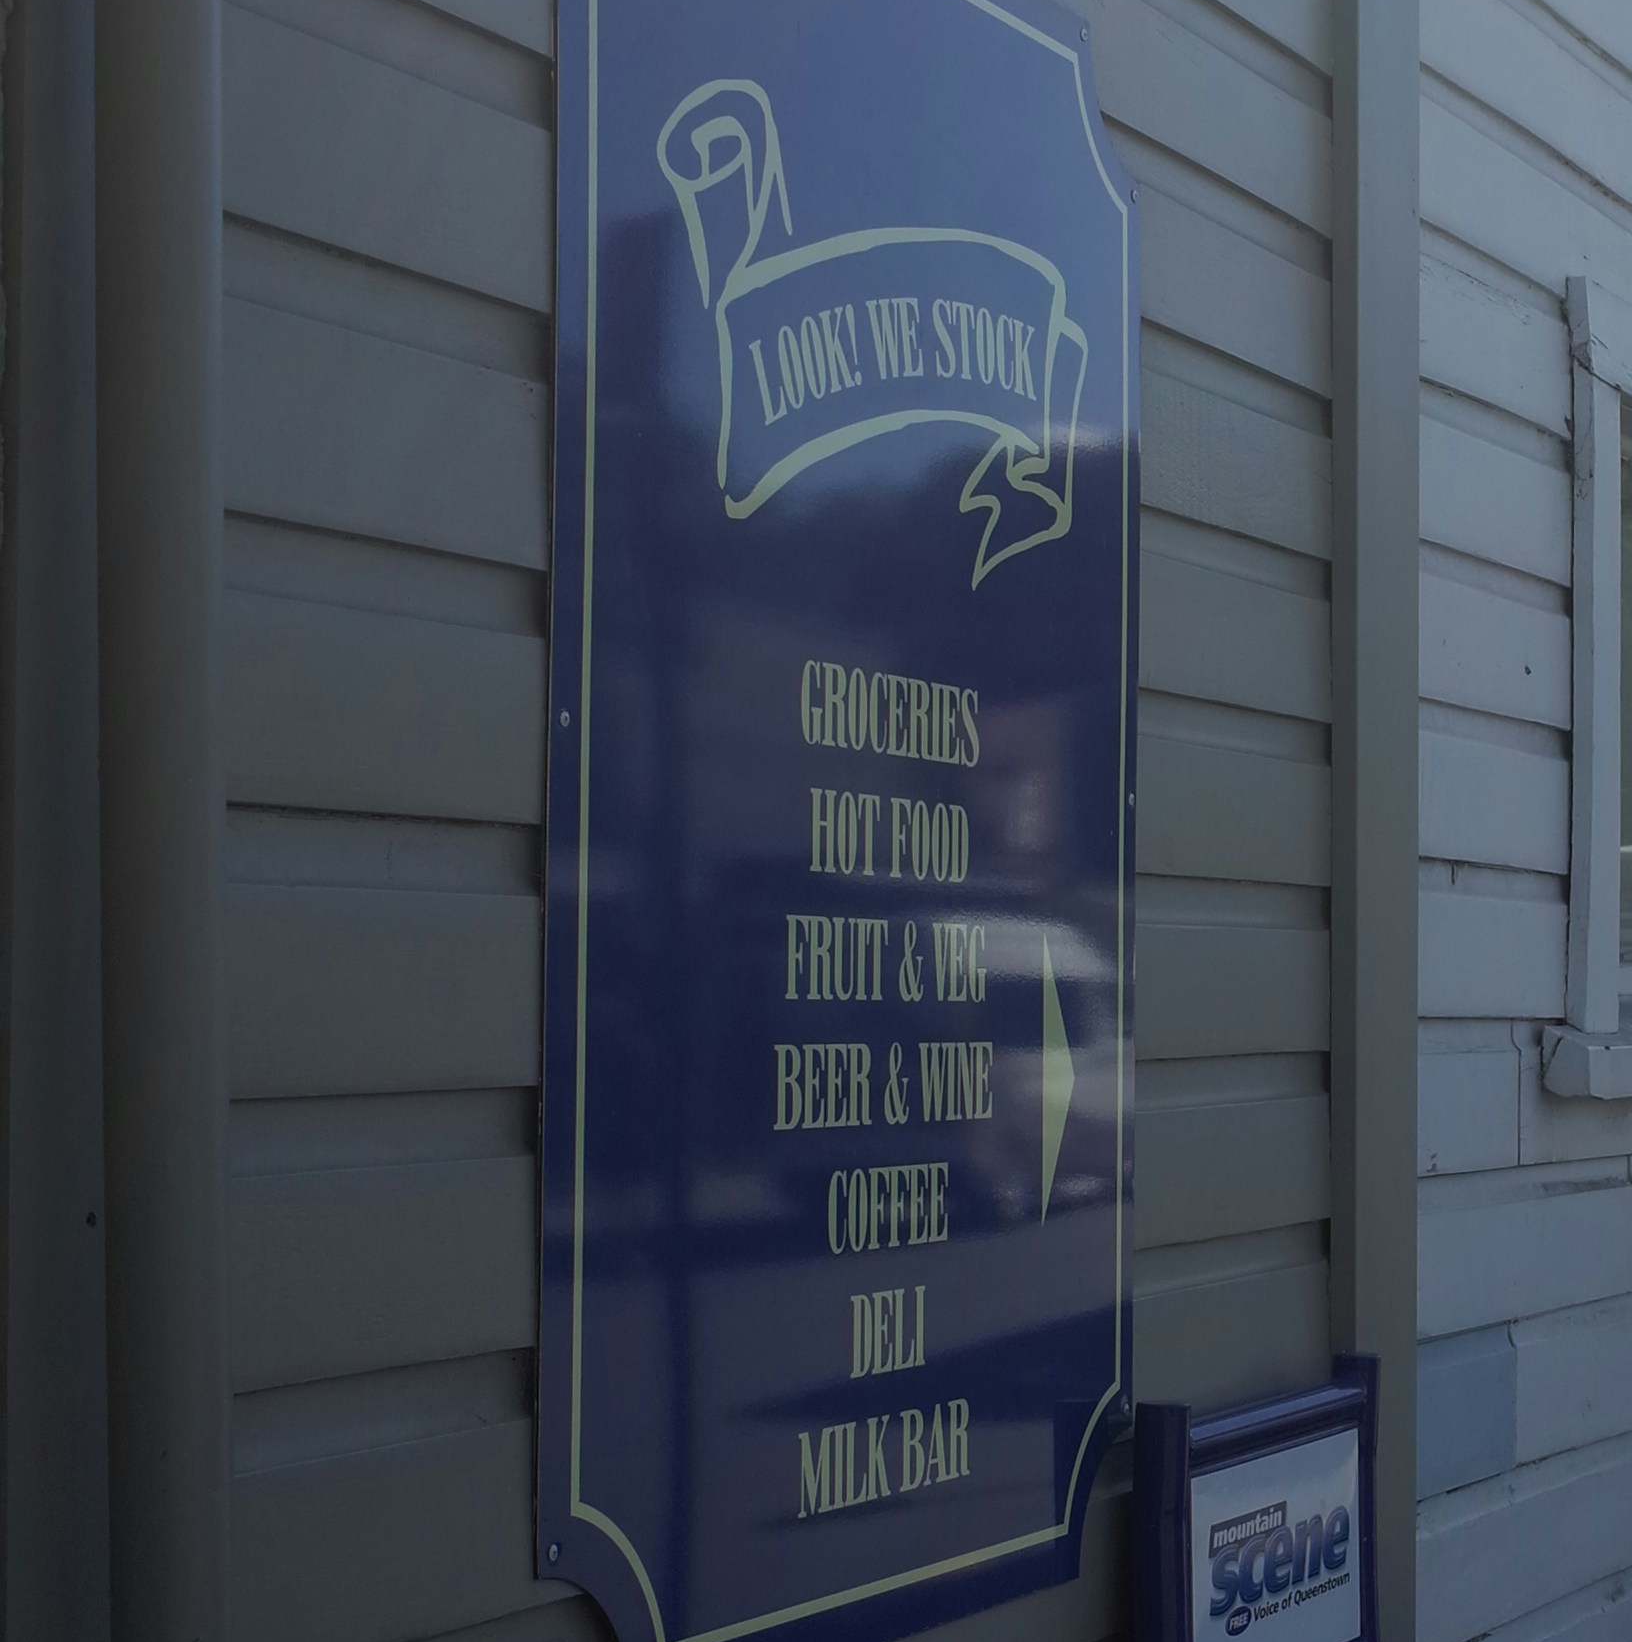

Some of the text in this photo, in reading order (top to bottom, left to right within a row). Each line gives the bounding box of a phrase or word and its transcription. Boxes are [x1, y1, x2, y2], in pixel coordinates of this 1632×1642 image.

[750, 297, 1038, 426] LOOK! WE STOCK
[801, 658, 981, 769] GROCERIES
[809, 787, 971, 884] HOT FOOD
[784, 913, 987, 1004] FRUIT & VEG
[773, 1040, 994, 1131] BEER & WINE
[827, 1162, 949, 1256] COFFEE
[849, 1285, 926, 1380] DELI
[798, 1398, 971, 1520] MILK BAR
[1209, 1504, 1351, 1618] scene
[1212, 1507, 1284, 1550] mountain
[1228, 1572, 1351, 1633] FREE Voice of Queenstown
